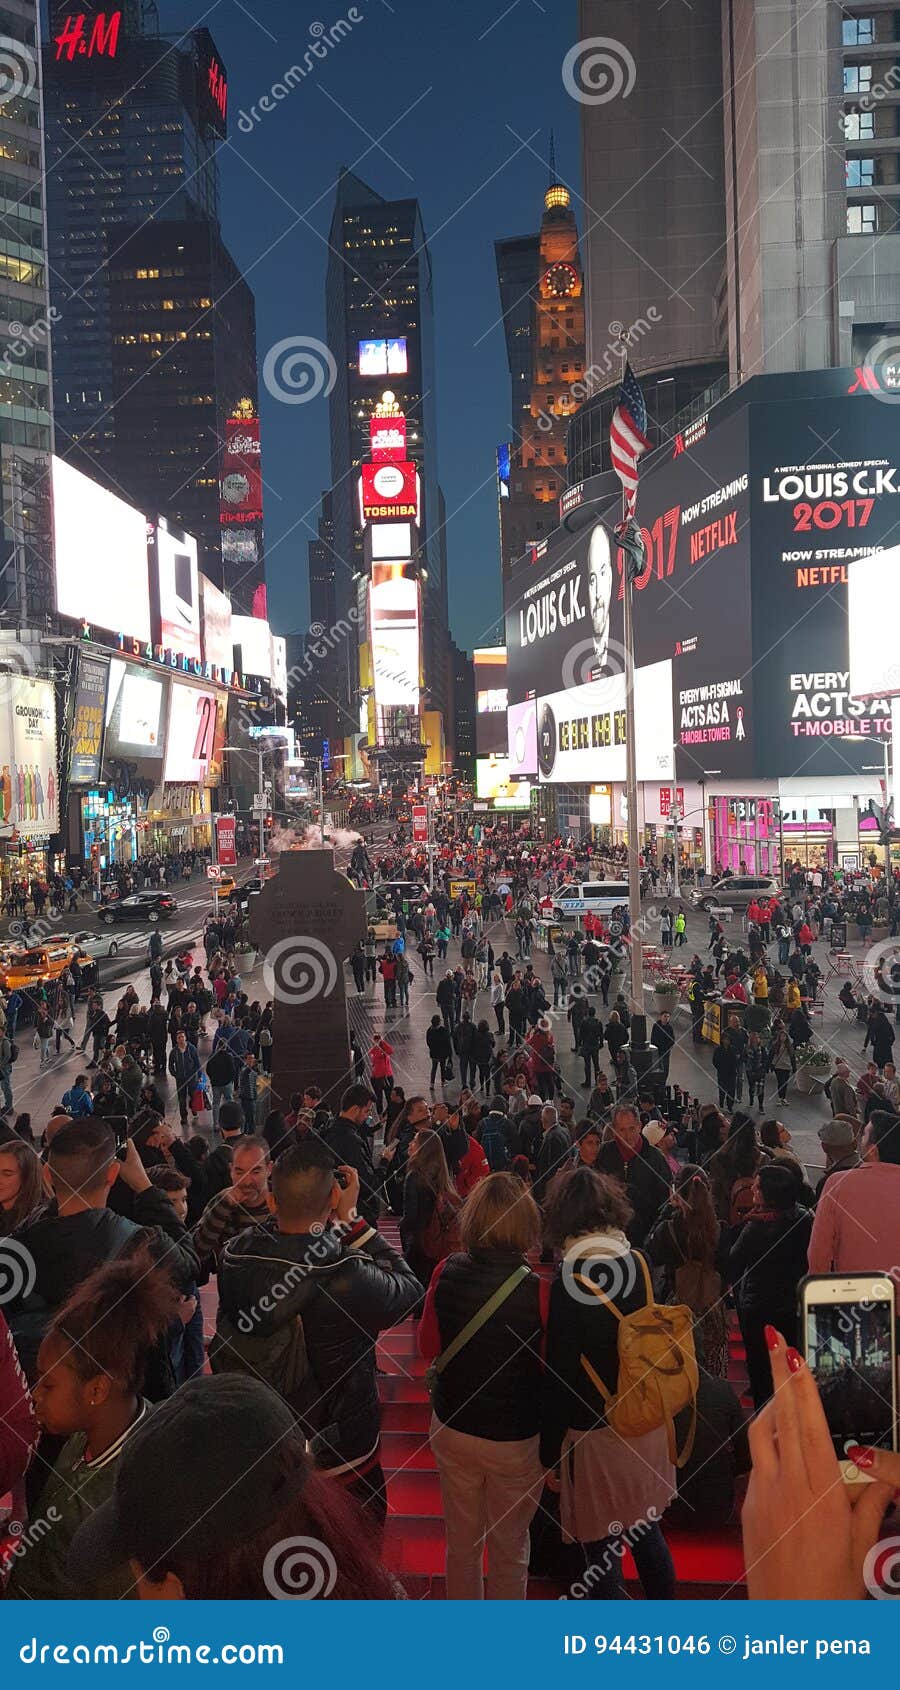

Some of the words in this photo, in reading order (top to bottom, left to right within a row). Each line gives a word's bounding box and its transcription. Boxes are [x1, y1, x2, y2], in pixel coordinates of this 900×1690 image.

[55, 11, 121, 61] H&M
[208, 57, 227, 121] H&M
[371, 410, 405, 418] TOSHIBA
[684, 413, 709, 437] MARRIOTT
[780, 465, 806, 473] NETFLIX
[806, 463, 836, 471] ORIGINAL
[836, 461, 863, 469] COMEDY
[681, 502, 701, 525] NOW
[701, 473, 749, 514] STREAMING
[763, 472, 849, 502] LOUIS
[364, 505, 416, 517] TOSHIBA
[793, 499, 875, 532] 2017
[690, 511, 738, 564] NETFLIX
[782, 551, 812, 562] NOW
[520, 590, 557, 647] LOUIS
[558, 574, 586, 627] C.K.
[680, 687, 700, 705] EVERY
[700, 683, 717, 701] WI-FI
[717, 679, 743, 698] SIGNAL
[791, 672, 849, 690] EVERY
[681, 704, 706, 728] ACTS
[706, 701, 720, 725] AS
[721, 700, 730, 723] A
[792, 692, 866, 717] ACTS
[28, 718, 39, 728] DAY
[680, 729, 708, 744] T-MOBILE
[707, 726, 731, 742] TOWER
[791, 720, 870, 736] T-MOBILE
